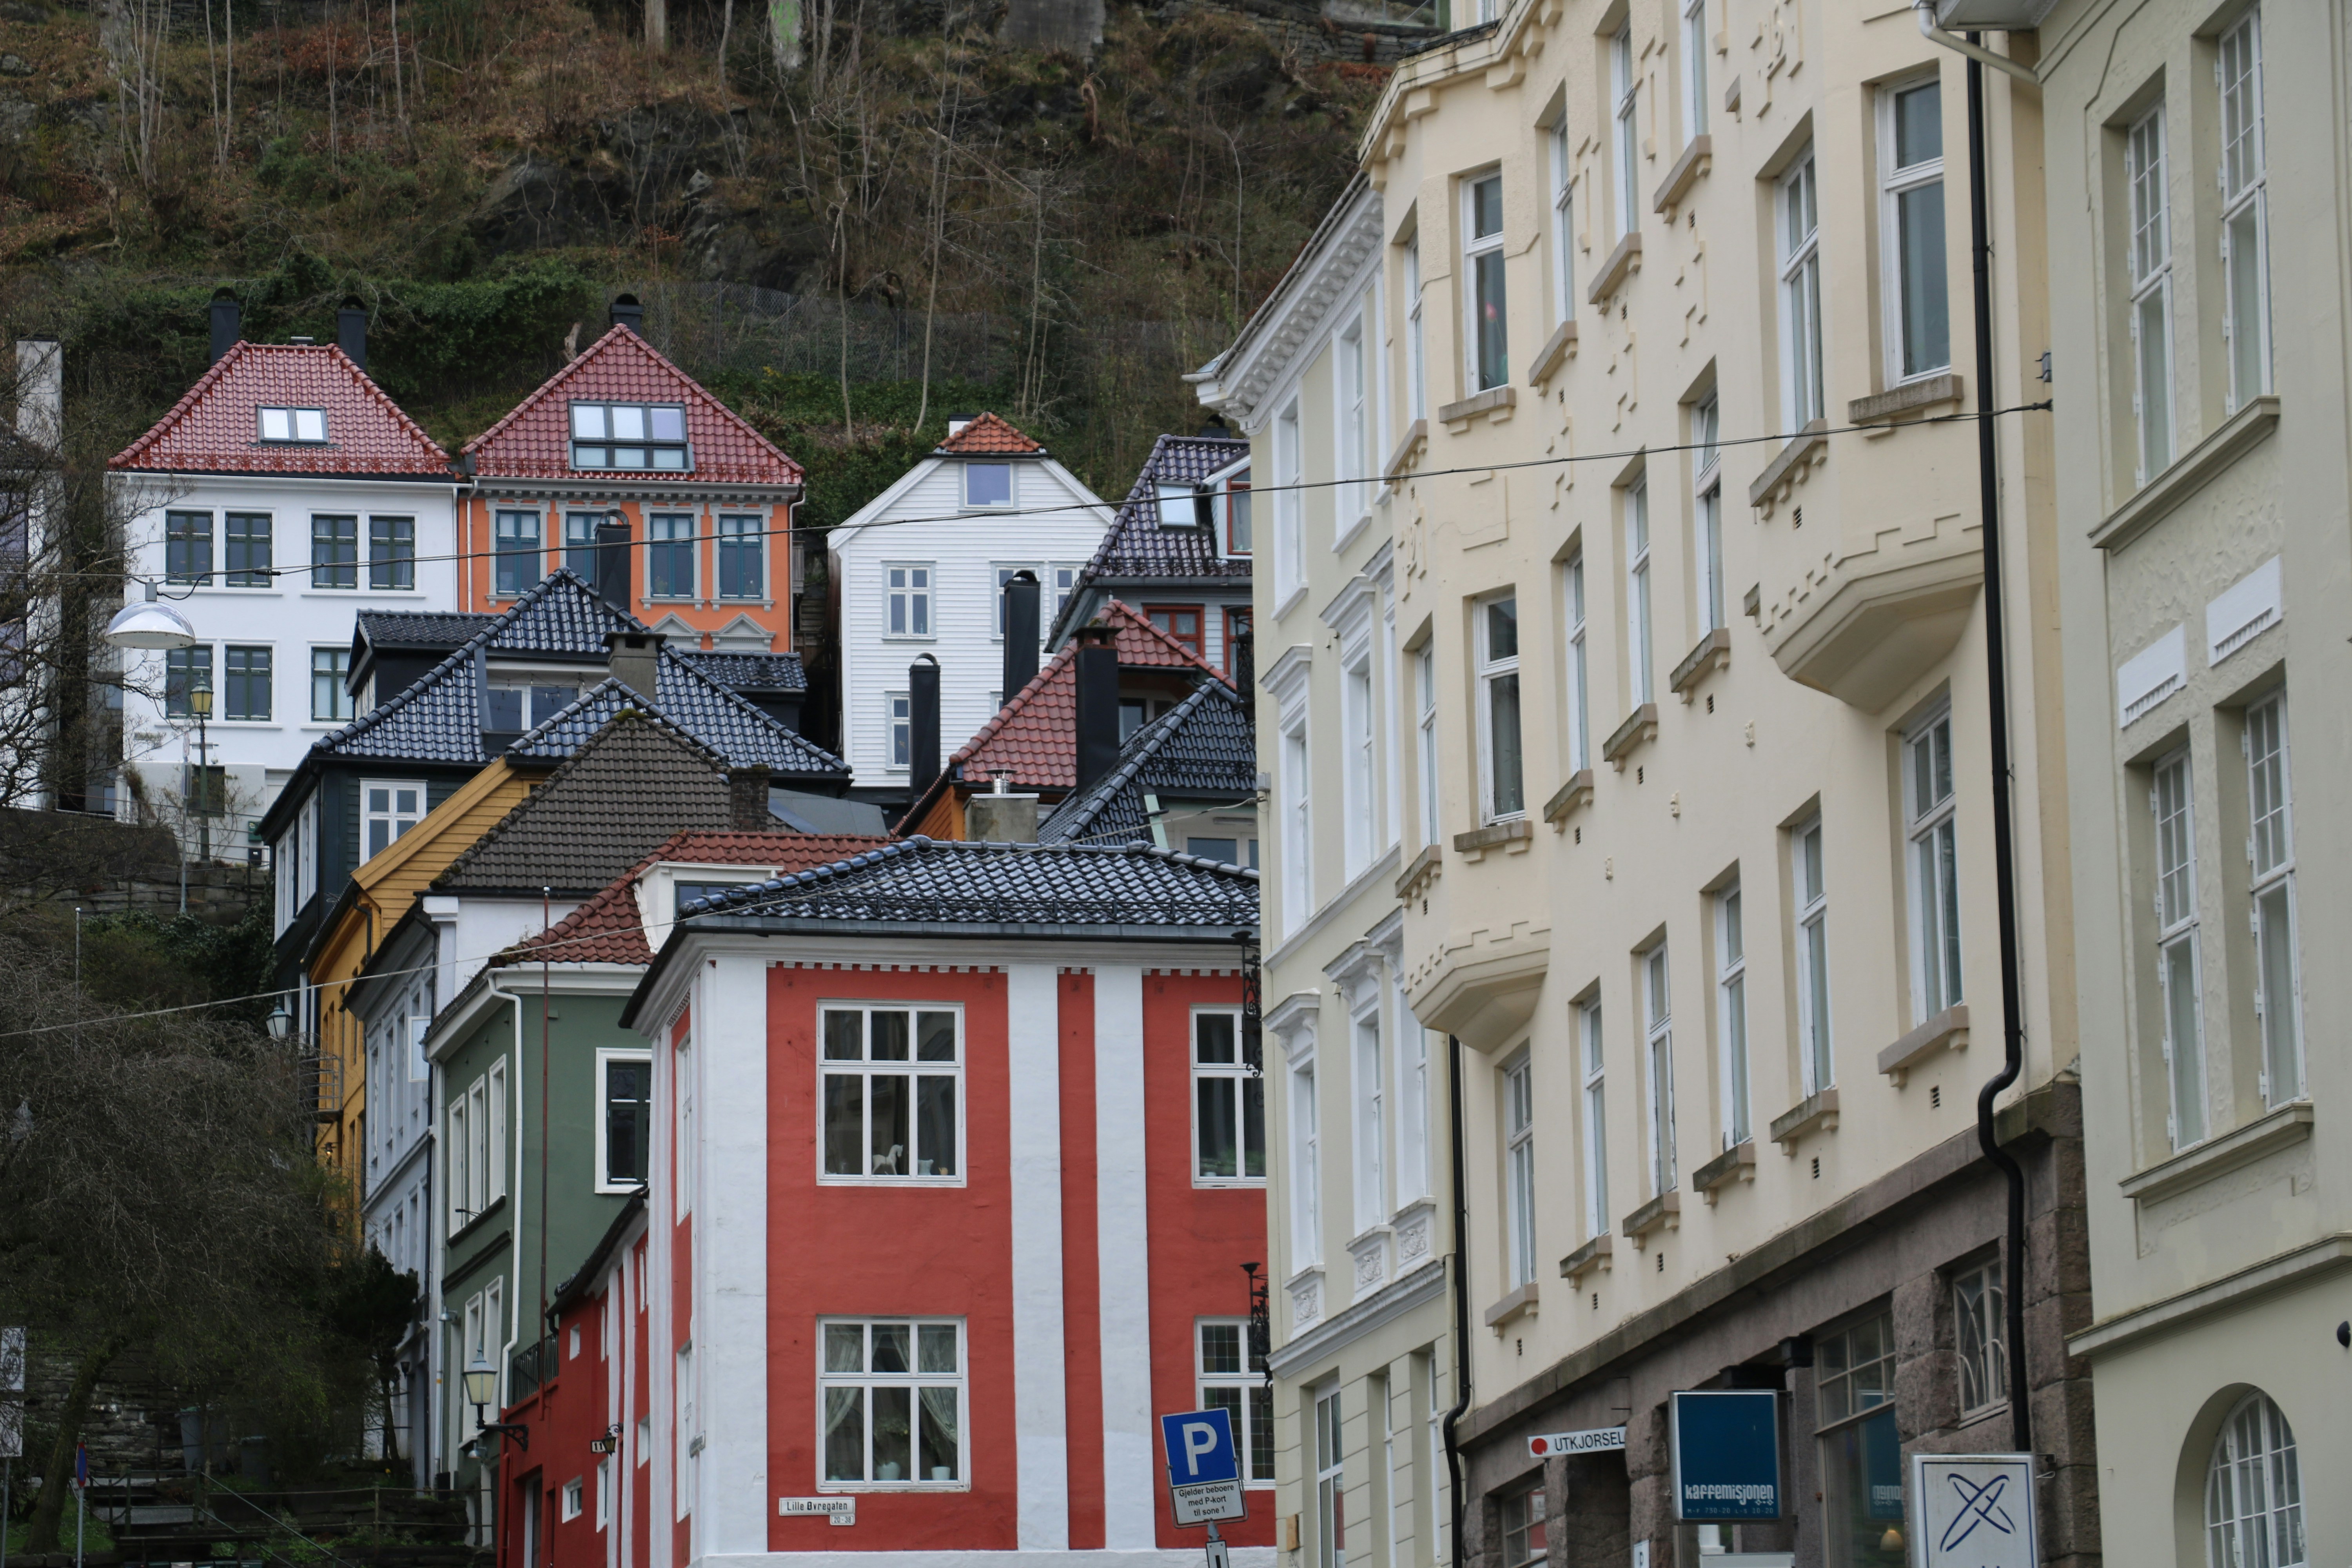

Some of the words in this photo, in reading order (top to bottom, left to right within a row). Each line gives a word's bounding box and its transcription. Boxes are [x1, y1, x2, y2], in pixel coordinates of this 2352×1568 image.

[1182, 1422, 1217, 1475] P
[1555, 1432, 1625, 1451] UTKJØRSEL
[1179, 1488, 1204, 1498] Gjelder
[1206, 1485, 1234, 1494] beboere
[1686, 1485, 1774, 1505] kaffemisjonen
[787, 1502, 804, 1511] Lille
[807, 1501, 847, 1512] Øvregaten
[1188, 1498, 1203, 1506] med
[1205, 1495, 1226, 1504] P-kort
